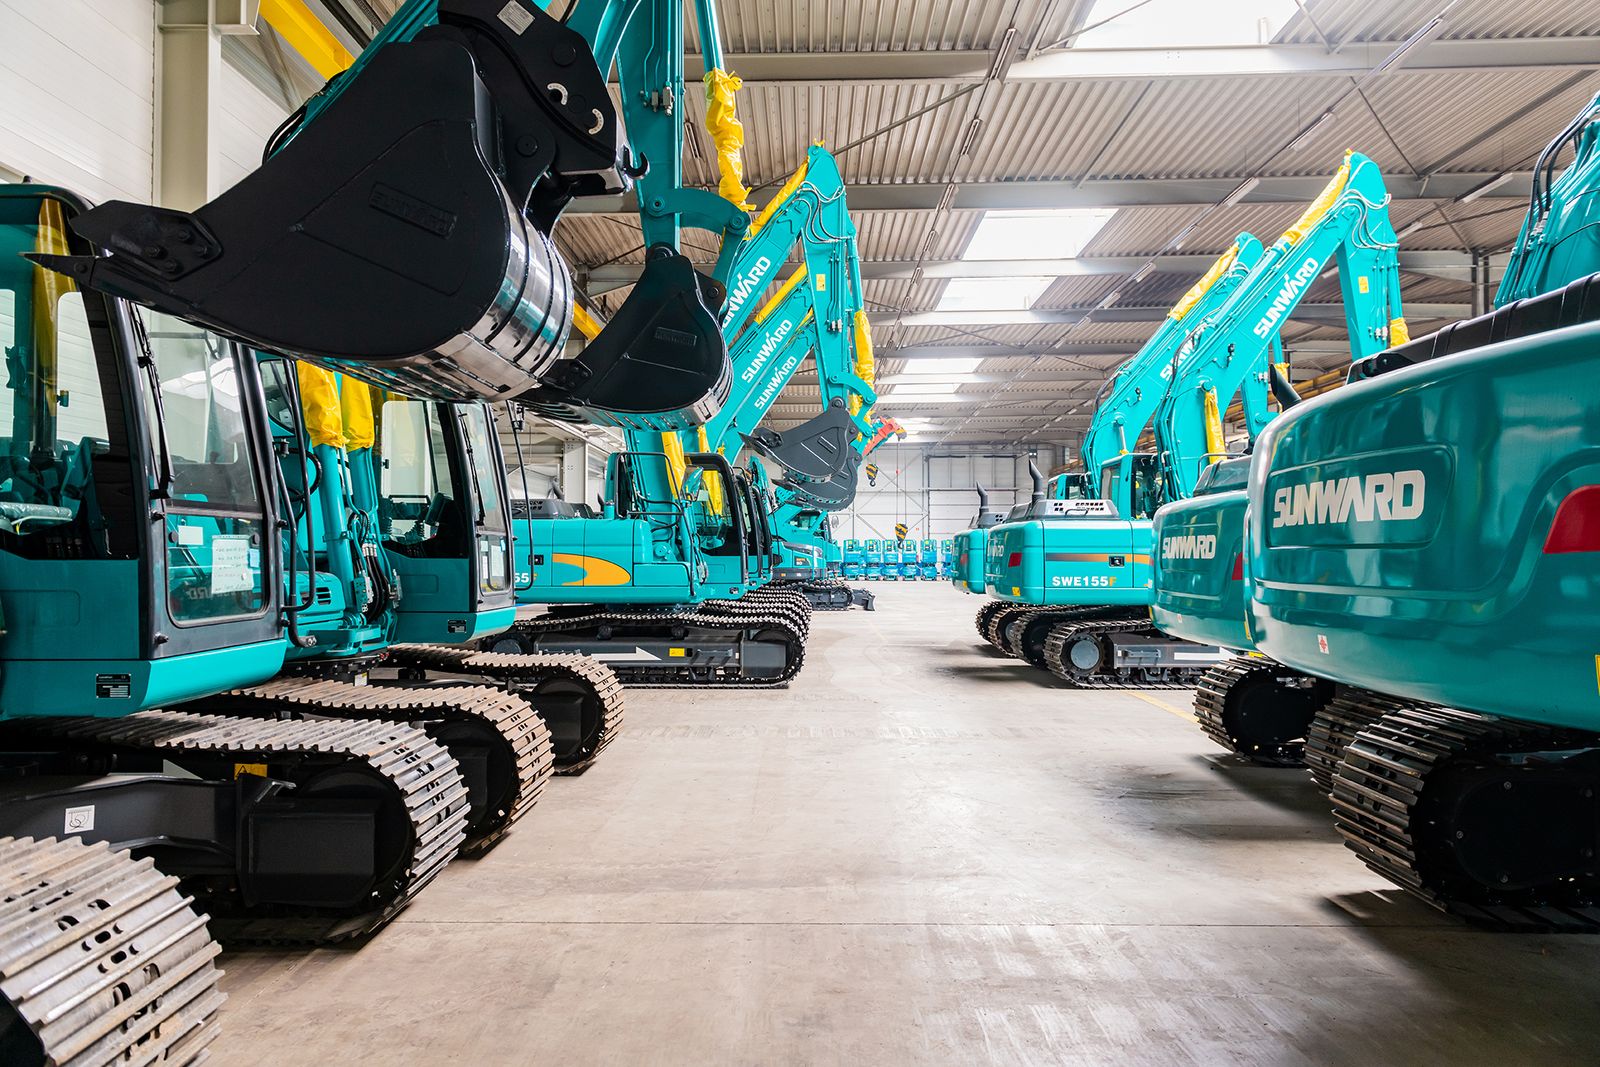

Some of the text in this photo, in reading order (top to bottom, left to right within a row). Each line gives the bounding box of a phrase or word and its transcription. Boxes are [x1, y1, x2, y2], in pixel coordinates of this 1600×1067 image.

[722, 256, 771, 329] UNWARD
[1253, 257, 1319, 339] SUNWARD
[741, 319, 793, 384] SUNWARD
[754, 356, 797, 410] SUNWARD
[1273, 469, 1426, 528] SUNWARD
[1162, 534, 1217, 560] SUNWARD
[1052, 575, 1117, 587] SWE155F
